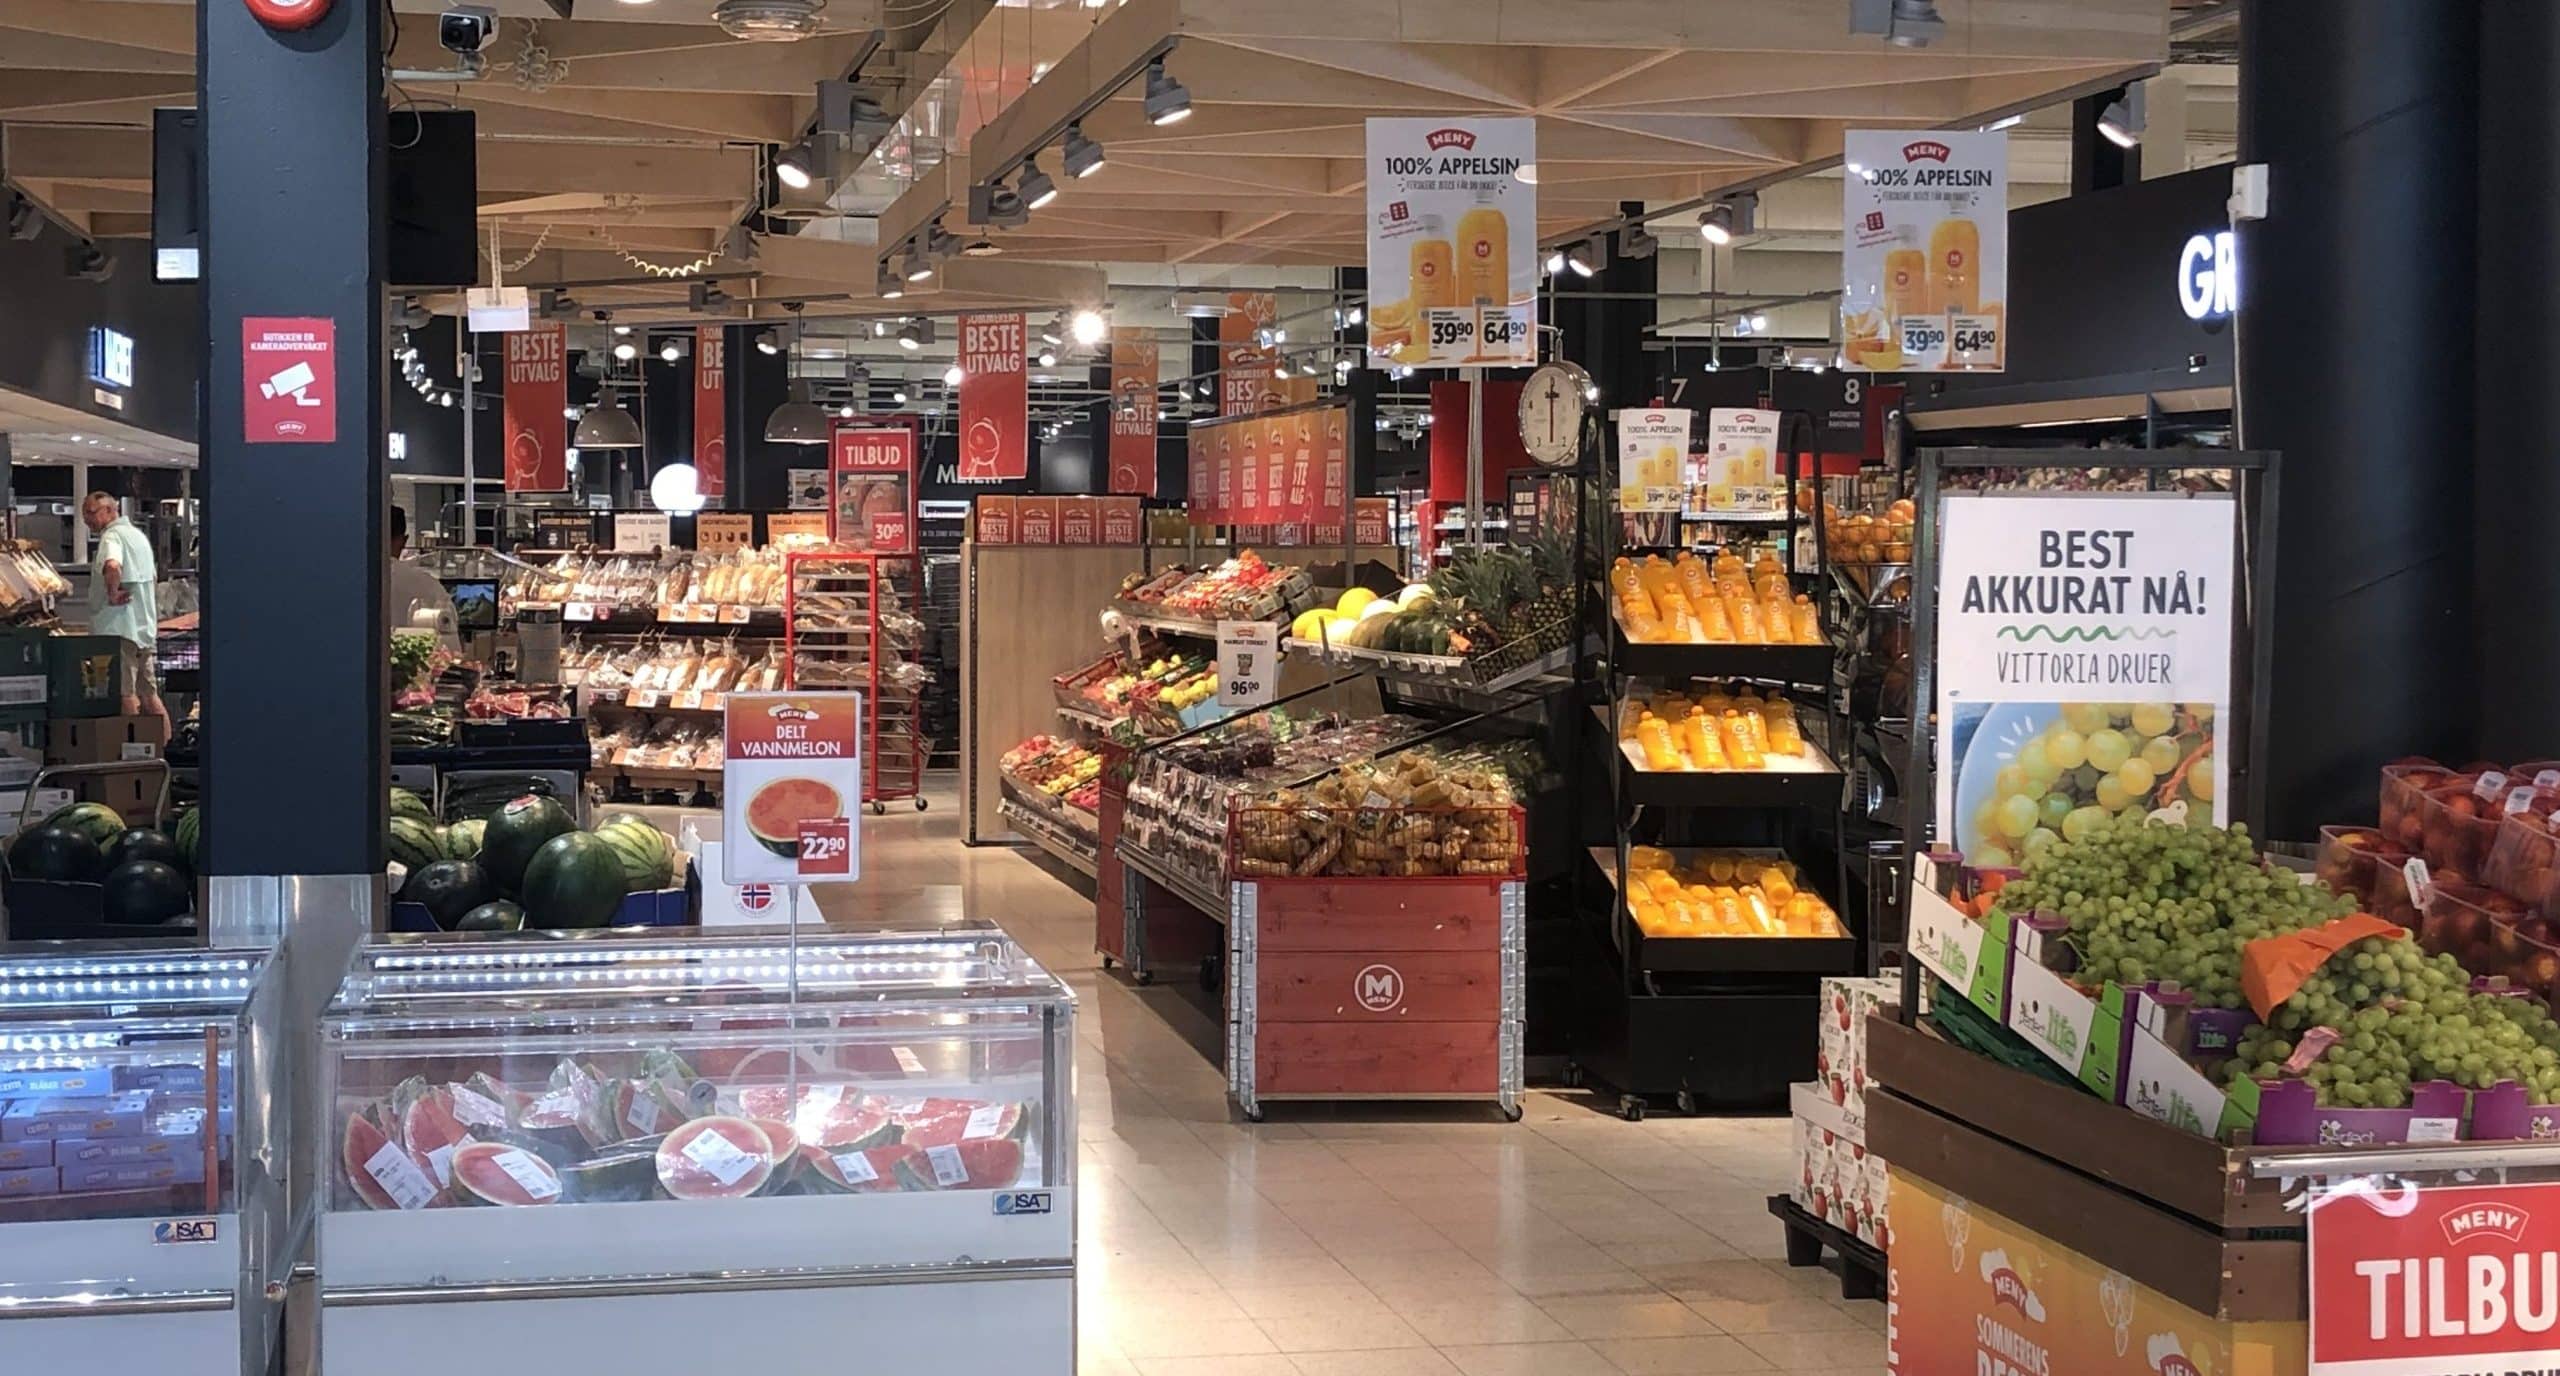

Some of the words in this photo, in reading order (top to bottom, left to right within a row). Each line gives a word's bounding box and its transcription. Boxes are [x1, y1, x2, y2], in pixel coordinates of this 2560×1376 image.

[1433, 132, 1471, 146] MENY
[1908, 144, 1945, 158] MENY
[1385, 157, 1432, 175] 100%
[1439, 157, 1520, 175] APPELSIN
[1864, 169, 1908, 186] 00%
[1914, 170, 1992, 187] APPELSIN
[511, 333, 559, 361] BESTE
[966, 324, 1020, 353] BESTE
[511, 362, 559, 383] UTVALG
[966, 352, 1020, 373] UTVALG
[1226, 380, 1254, 401] BES
[1671, 378, 1688, 404] 7
[1844, 379, 1860, 404] 8
[1114, 421, 1152, 435] UTVALG
[845, 445, 901, 465] TILBUD
[1315, 526, 1341, 536] BESTE
[1356, 525, 1382, 535] BESTE
[2040, 530, 2134, 569] BEST
[1961, 575, 2131, 614] AKKURAT
[2142, 570, 2206, 615] NÅ!
[1997, 652, 2099, 684] VITTORIA
[2108, 652, 2172, 684] DRUER
[776, 725, 807, 740] DELT
[741, 740, 841, 756] VANNMELON
[1365, 974, 1392, 998] M
[1016, 1194, 1040, 1208] ISA
[177, 1222, 204, 1237] ISA
[2451, 1210, 2519, 1233] MENY
[1994, 1276, 2026, 1307] MENY
[2355, 1251, 2559, 1340] TILBU
[1976, 1313, 2049, 1376] SOMMERENS
